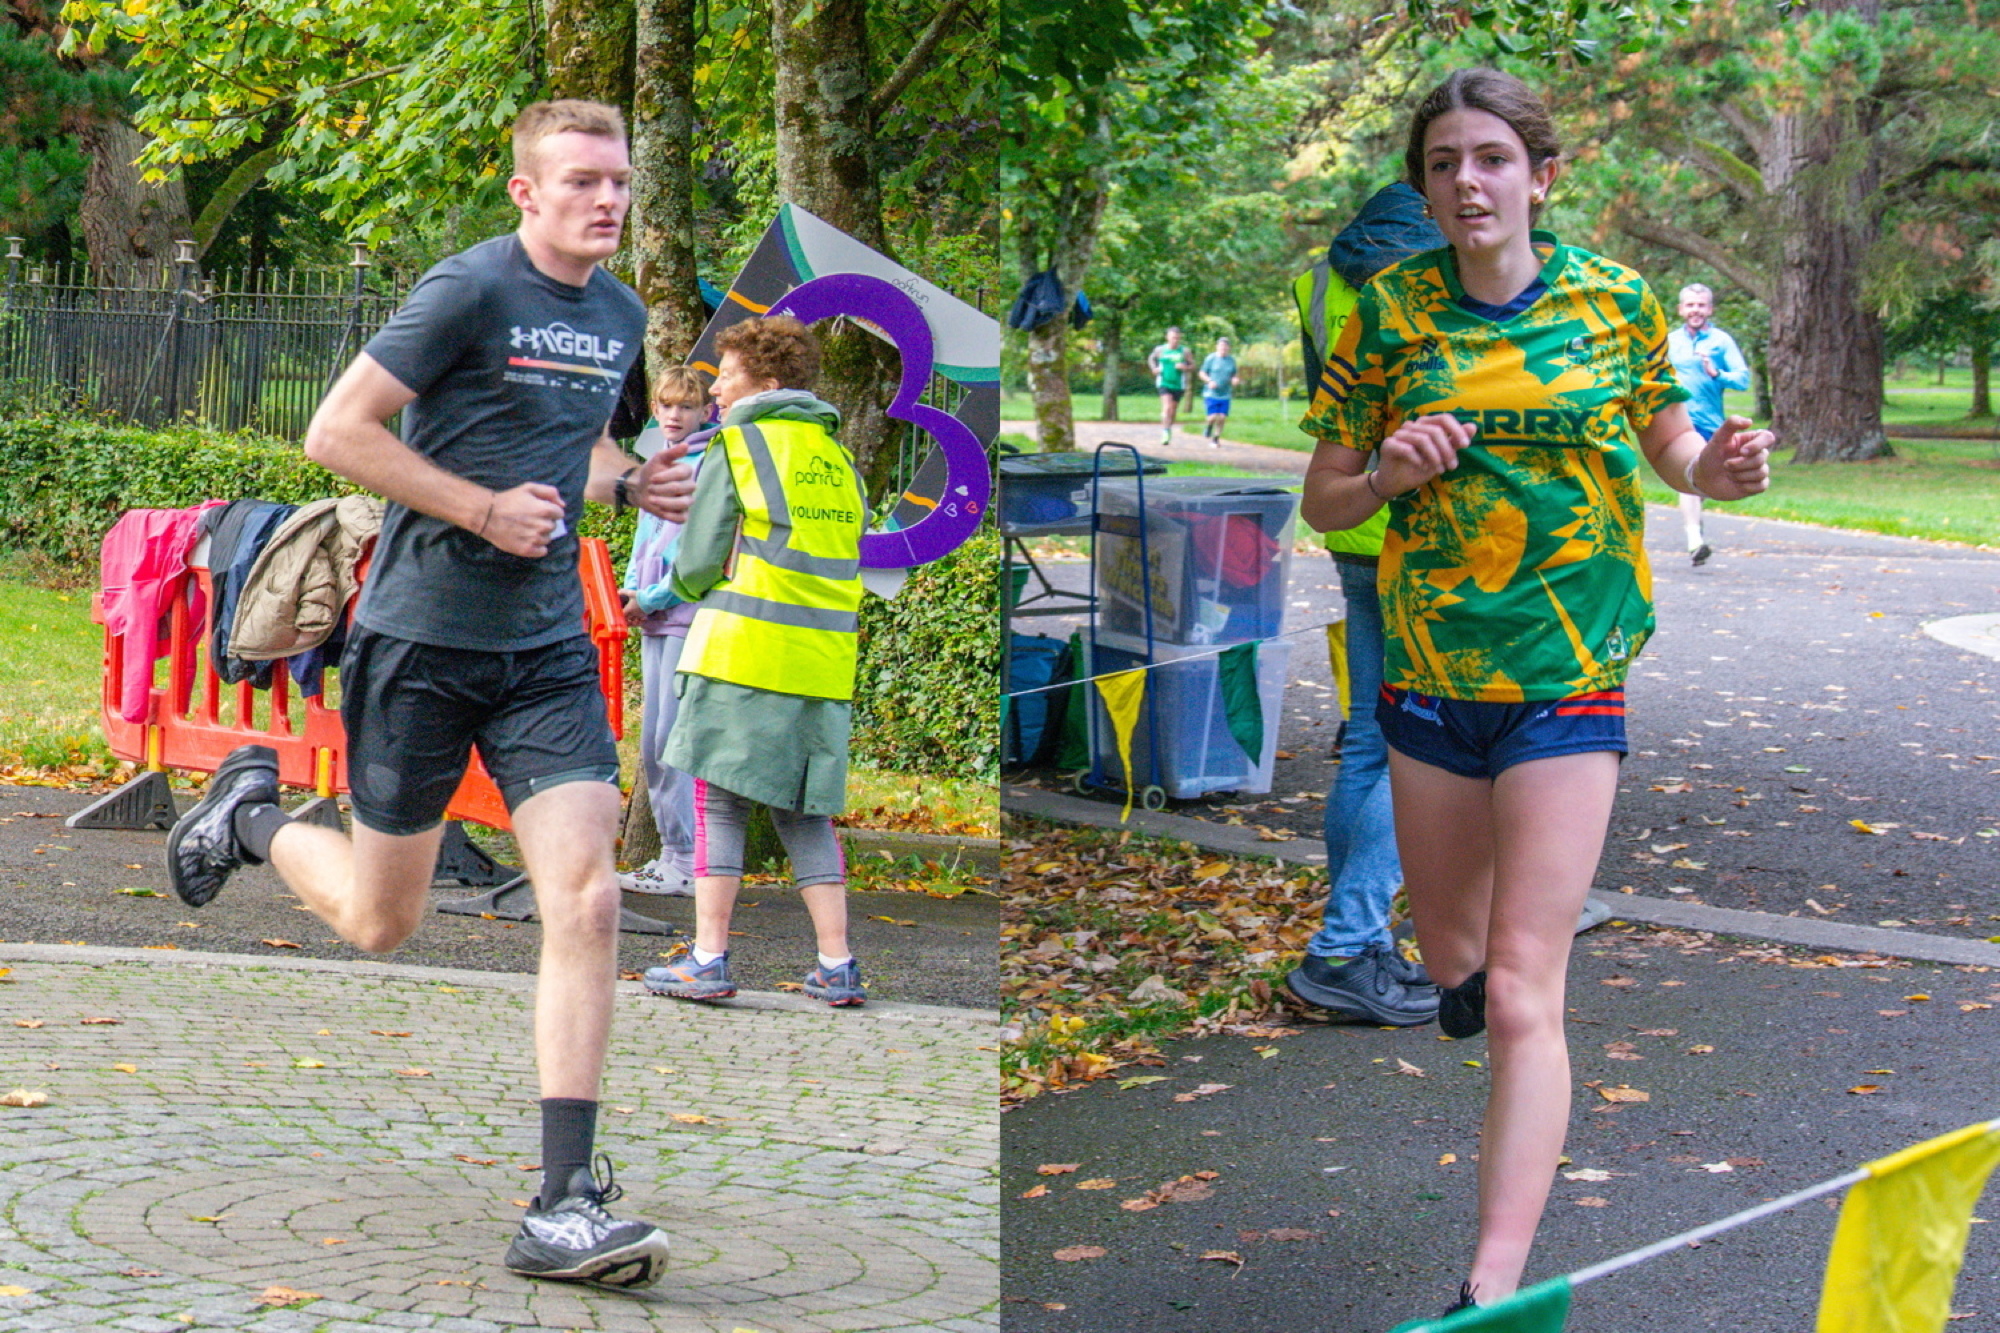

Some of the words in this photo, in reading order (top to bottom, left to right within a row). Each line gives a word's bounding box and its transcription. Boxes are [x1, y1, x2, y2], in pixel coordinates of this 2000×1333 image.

[1410, 408, 1593, 435] RRY
[795, 471, 845, 488] parkru
[790, 505, 857, 524] VOLUNTEE
